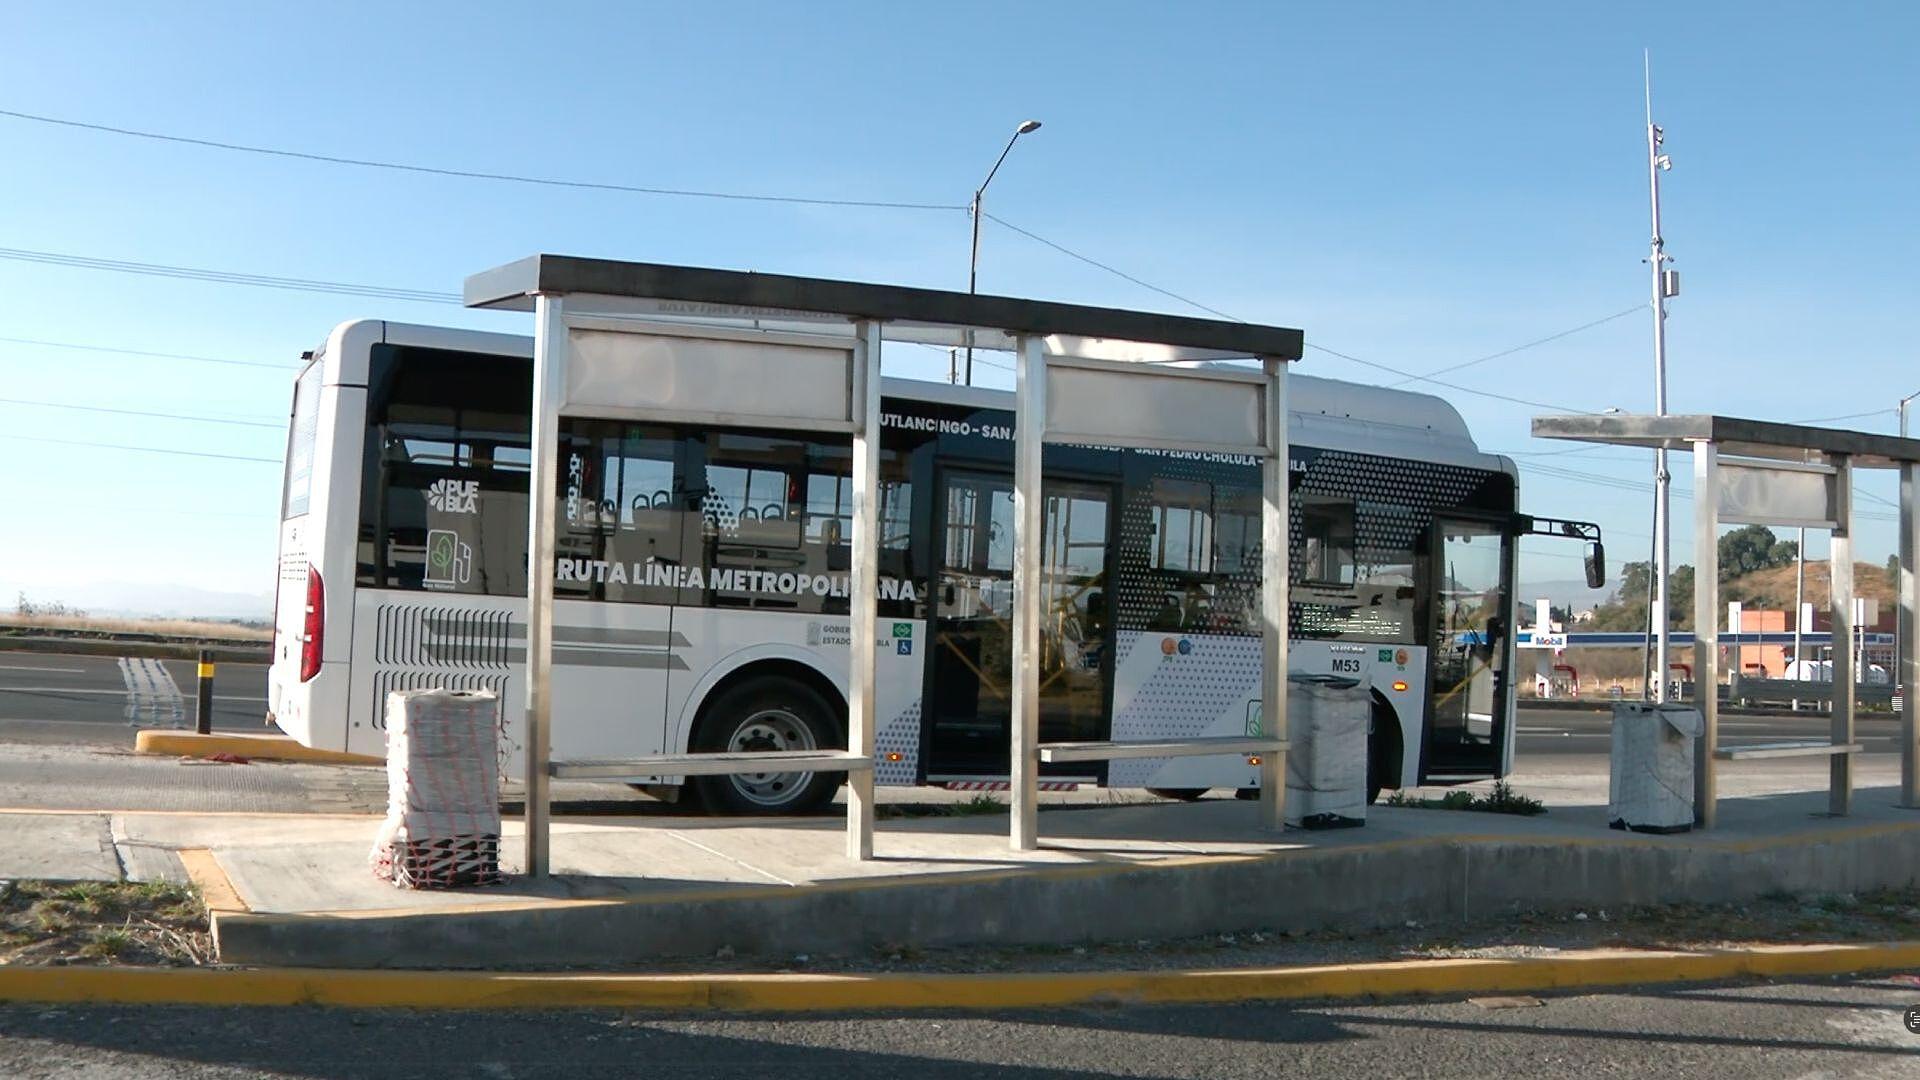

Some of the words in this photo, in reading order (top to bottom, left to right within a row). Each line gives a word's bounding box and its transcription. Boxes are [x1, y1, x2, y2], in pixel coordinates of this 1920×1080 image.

[879, 413, 970, 435] UTLANCINGO
[982, 425, 1009, 439] SAN
[1203, 452, 1257, 467] CHOLULA
[446, 479, 479, 498] PUE
[445, 495, 477, 513] BLA
[557, 558, 628, 585] RUTA
[632, 555, 705, 589] LÍNEA
[710, 568, 916, 600] METROPOLINA
[823, 625, 851, 633] GOBIER
[1332, 659, 1360, 672] M53
